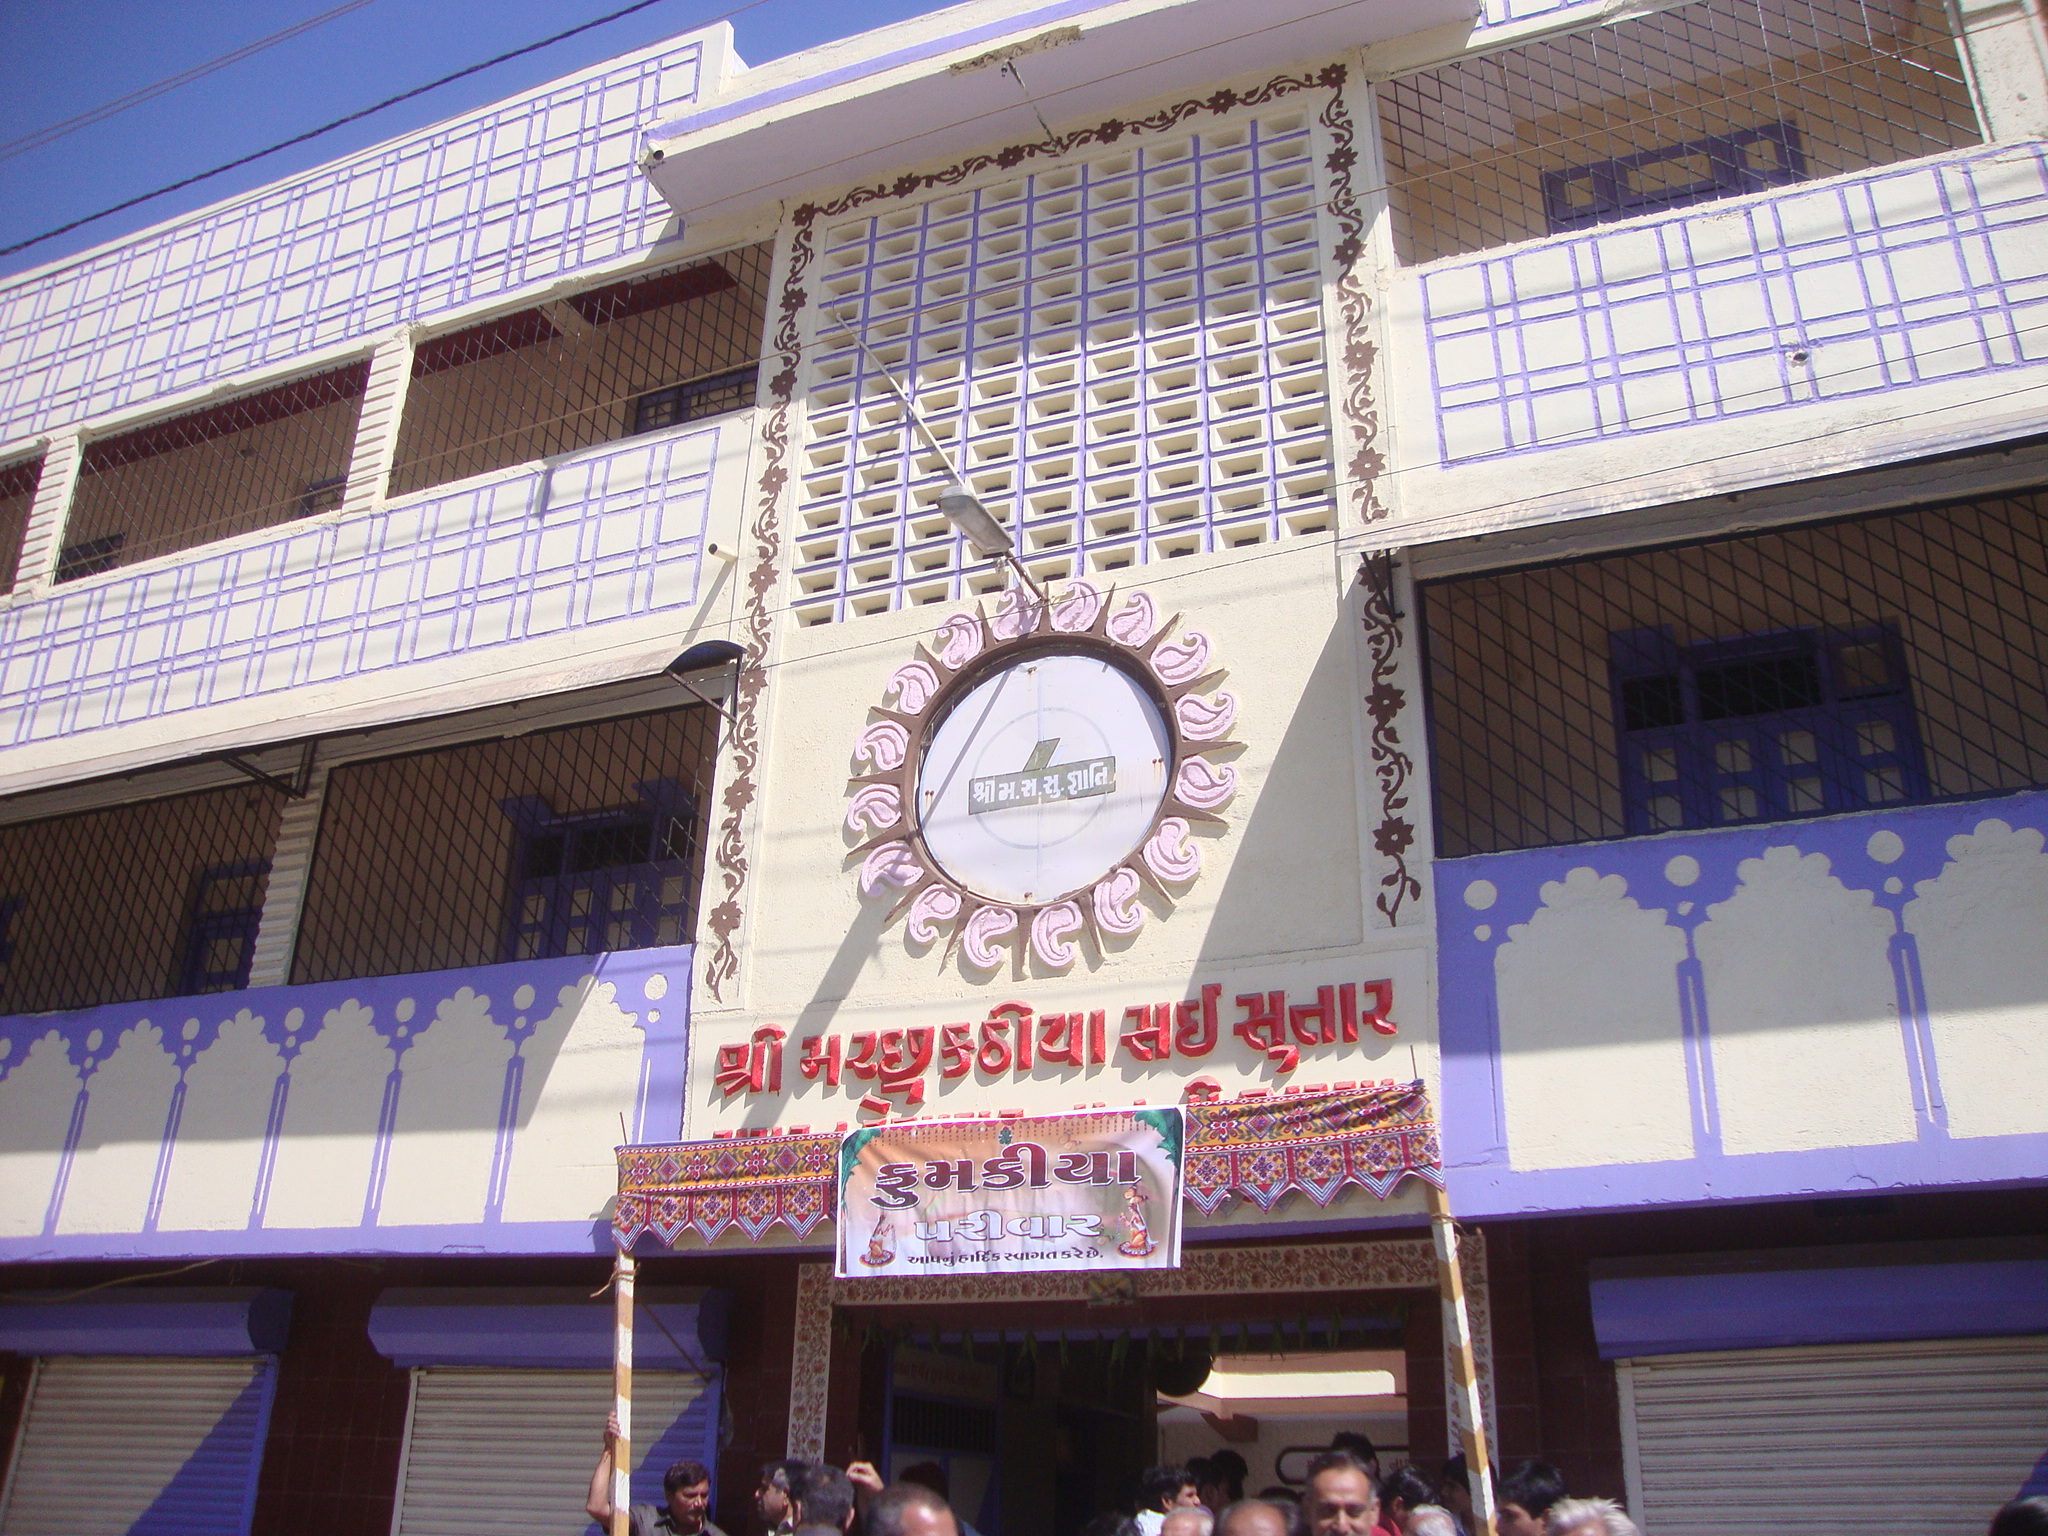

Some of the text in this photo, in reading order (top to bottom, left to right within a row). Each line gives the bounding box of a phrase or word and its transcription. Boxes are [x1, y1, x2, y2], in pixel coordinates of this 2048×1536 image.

[972, 780, 996, 804] શ્રી
[715, 1022, 787, 1098] શ્રી
[1119, 982, 1223, 1062] સઈ
[1232, 977, 1399, 1074] સુતાર
[913, 1210, 1103, 1243] પરીવાર
[1004, 1250, 1058, 1262] સ્વાગત
